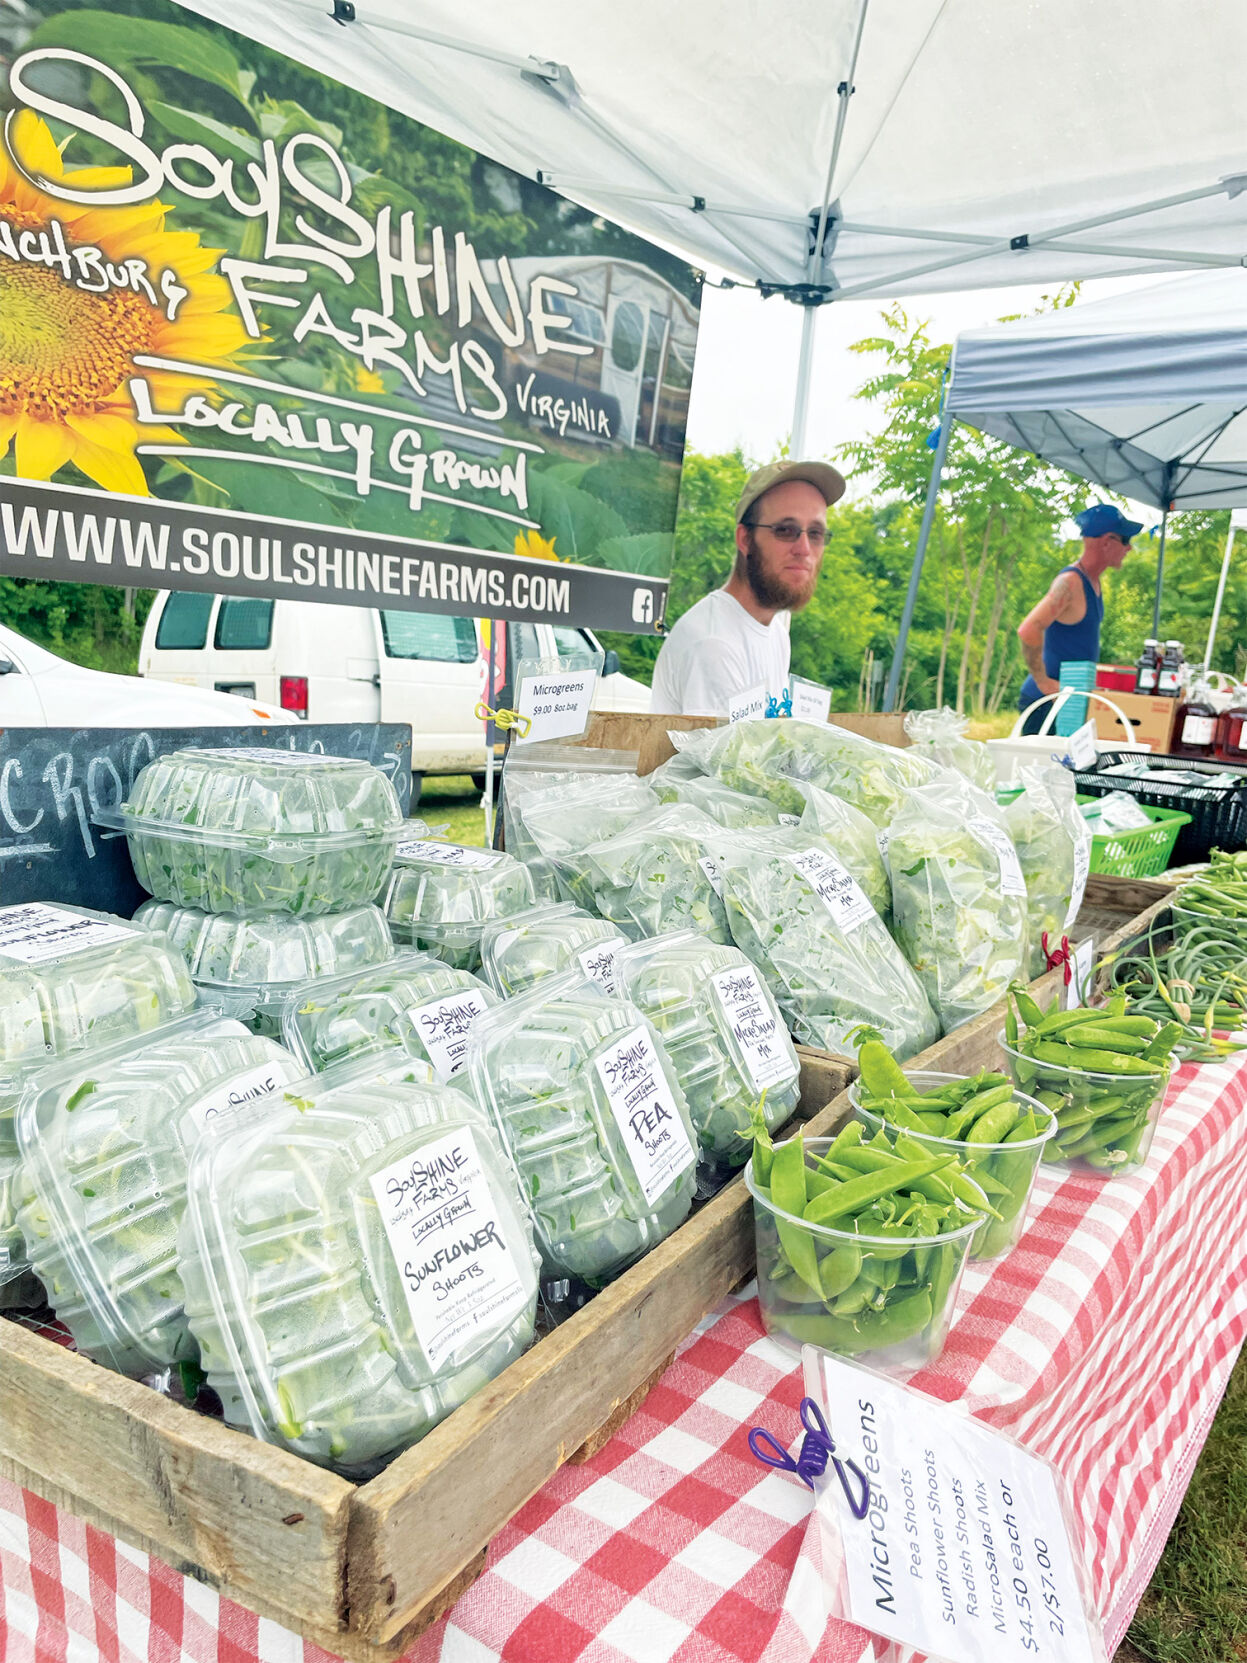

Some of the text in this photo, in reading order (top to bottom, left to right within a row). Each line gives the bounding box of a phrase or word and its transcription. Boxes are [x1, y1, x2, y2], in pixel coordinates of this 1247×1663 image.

[221, 257, 507, 420] FARMS
[130, 379, 528, 510] LOCALLY GROWN
[516, 373, 611, 437] VIRGINIA
[1, 502, 570, 613] WWW.SOULSHINEFARMS.COM
[533, 682, 584, 696] Microgreens
[533, 704, 552, 716] $9.00
[731, 699, 763, 723] Salad Mix
[629, 1102, 672, 1143] PEA
[645, 1128, 671, 1156] SHOOTS
[404, 1221, 506, 1292] SUNFLOWER
[432, 1261, 484, 1301] SHOOTS
[859, 1399, 897, 1615] Microgreens
[901, 1469, 923, 1579] Pea Shoots
[925, 1449, 956, 1625] Sunflower Shoots
[952, 1477, 980, 1617] Radish Shoots
[975, 1479, 1007, 1634] MicroSalad Mix
[1000, 1479, 1040, 1653] $4.50 each or
[1034, 1538, 1064, 1636] 2/$7.00
